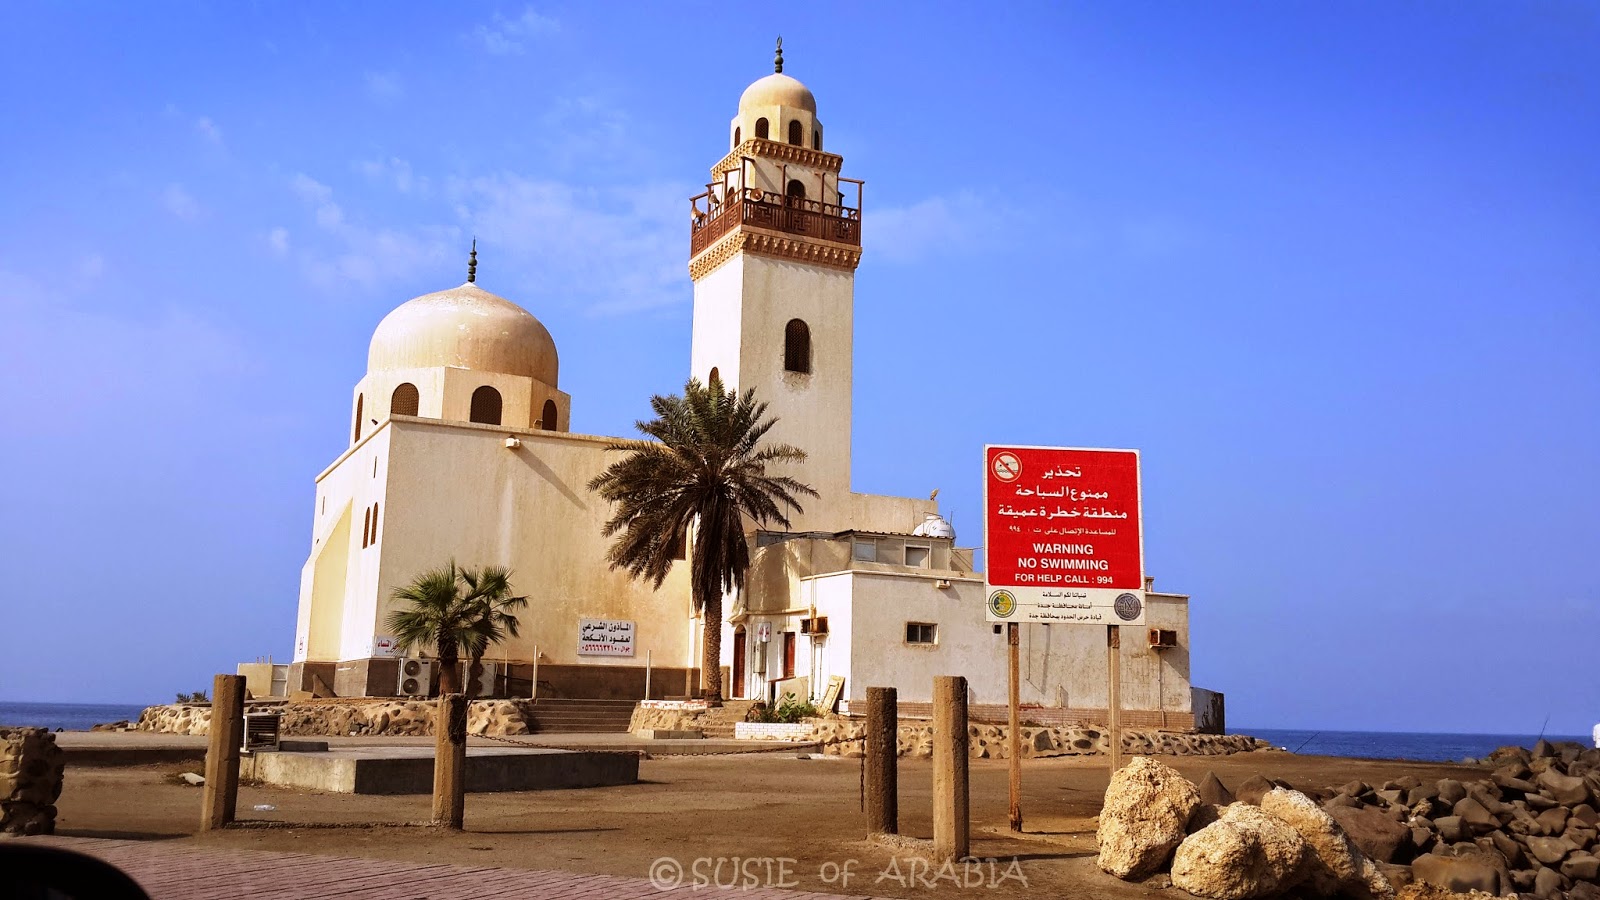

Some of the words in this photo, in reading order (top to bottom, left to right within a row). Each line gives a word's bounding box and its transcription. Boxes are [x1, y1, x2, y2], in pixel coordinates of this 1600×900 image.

[1042, 465, 1082, 479] تحذير
[1016, 485, 1069, 499] السباحة
[1070, 488, 1108, 502] ممنوع
[998, 504, 1038, 518] عميقة
[1040, 506, 1081, 520] خطرة
[1084, 506, 1127, 519] منطقة
[1009, 525, 1020, 533] ٩٩٤
[1044, 526, 1058, 535] على
[1085, 527, 1116, 535] للمساعدة
[1033, 543, 1094, 554] WARNING
[1018, 558, 1037, 568] NO
[1041, 559, 1109, 570] SWIMMING
[1015, 573, 1034, 582] FOR
[1037, 574, 1062, 583] HELP
[1064, 575, 1089, 584] CALL
[1097, 576, 1113, 584] 994
[582, 621, 607, 632] الشرعي
[609, 635, 631, 644] لعقود
